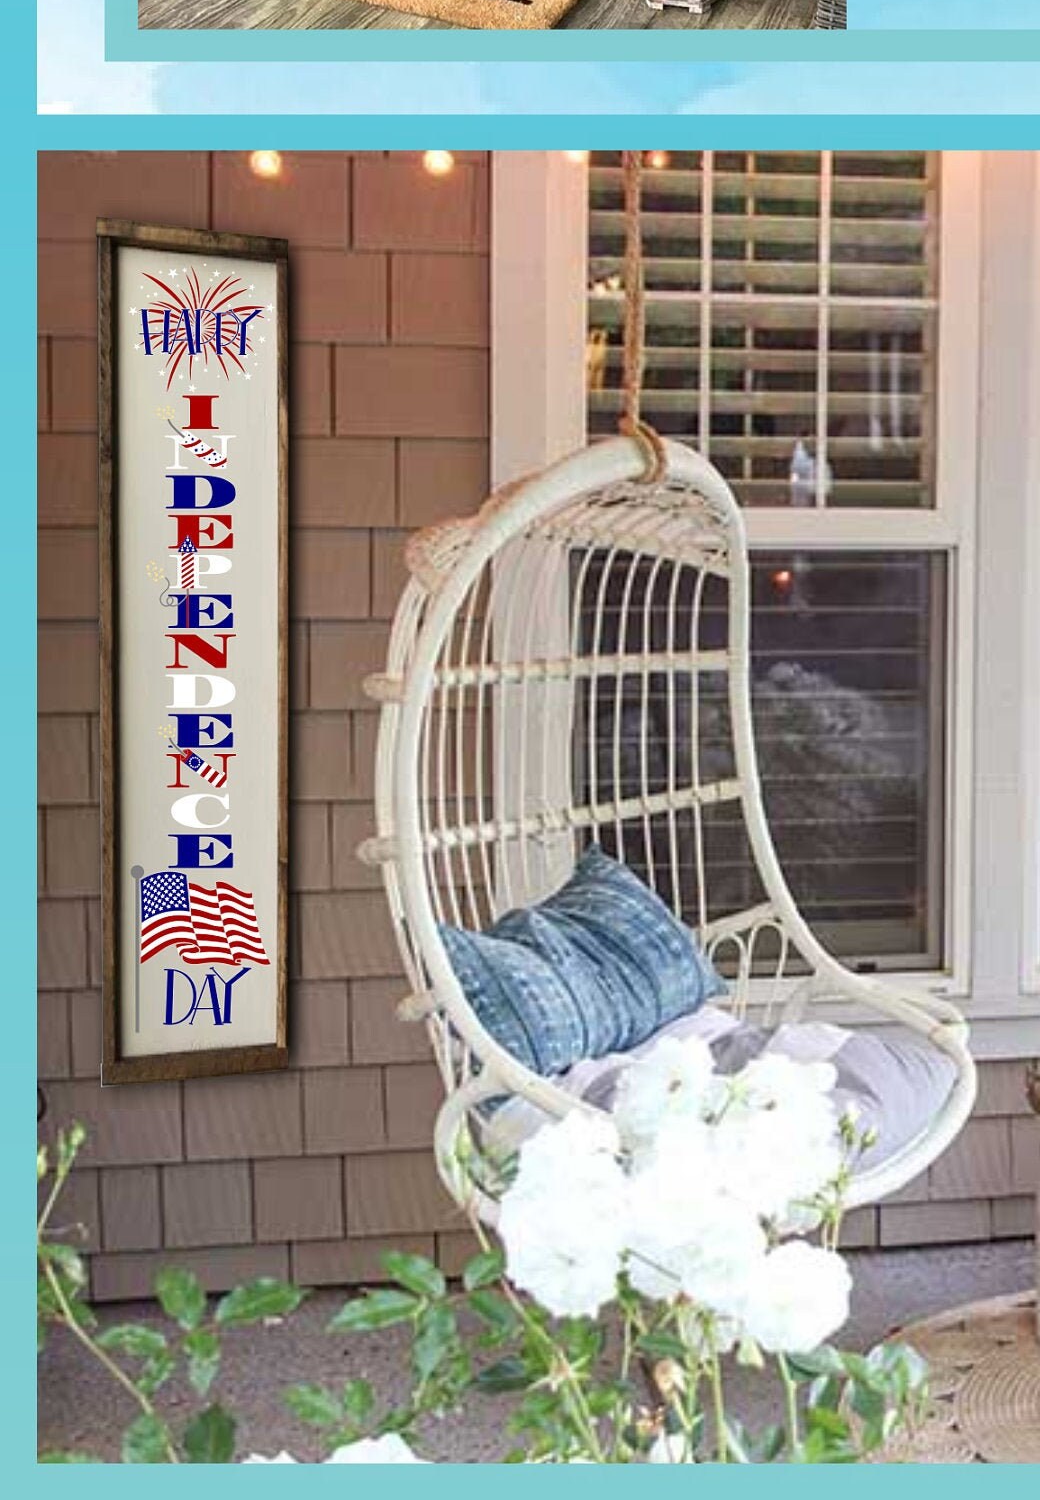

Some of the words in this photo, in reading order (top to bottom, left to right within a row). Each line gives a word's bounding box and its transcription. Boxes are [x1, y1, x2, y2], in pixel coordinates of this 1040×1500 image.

[138, 308, 263, 356] HAPPY
[164, 395, 237, 869] INDEPENDENCE
[162, 967, 252, 1026] DAY
